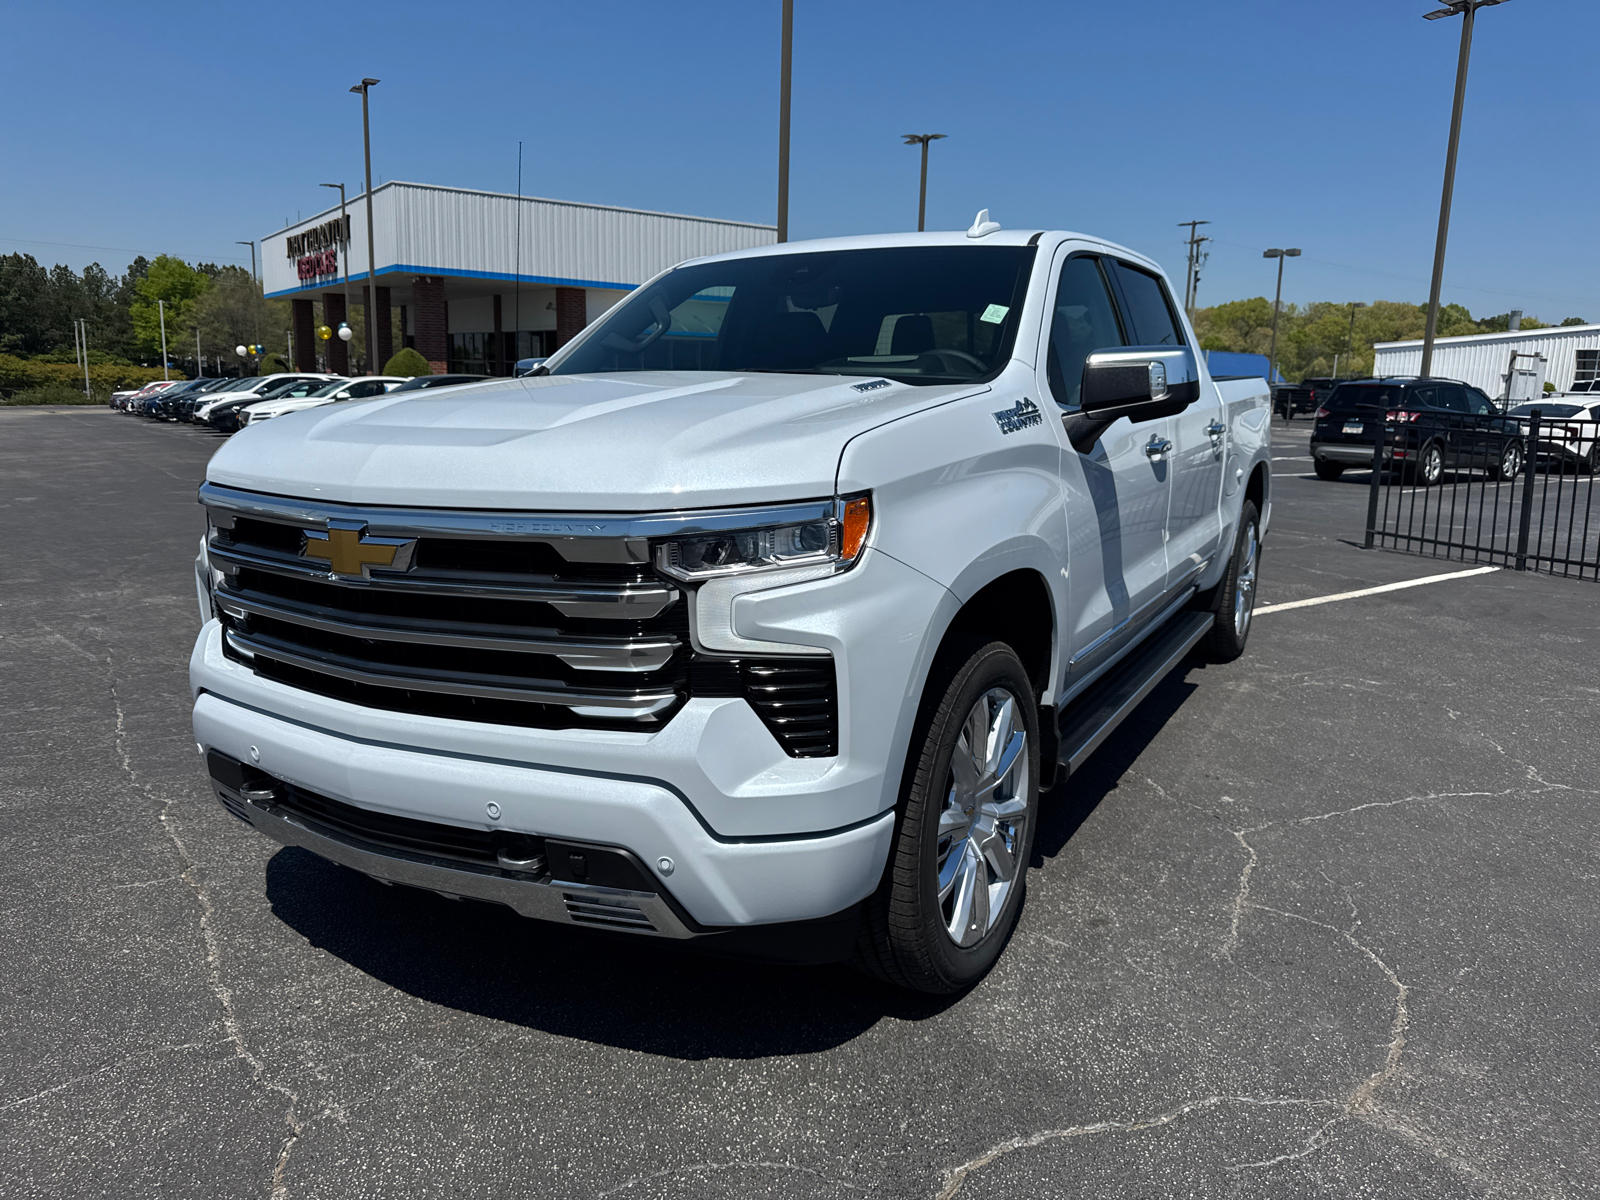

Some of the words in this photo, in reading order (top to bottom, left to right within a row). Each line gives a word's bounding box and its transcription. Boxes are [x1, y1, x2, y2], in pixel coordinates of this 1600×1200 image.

[297, 256, 316, 280] USED
[315, 249, 337, 276] CARS
[1000, 413, 1043, 435] COUNTRY
[490, 522, 526, 531] HIGH
[532, 523, 607, 533] COUNTRY
